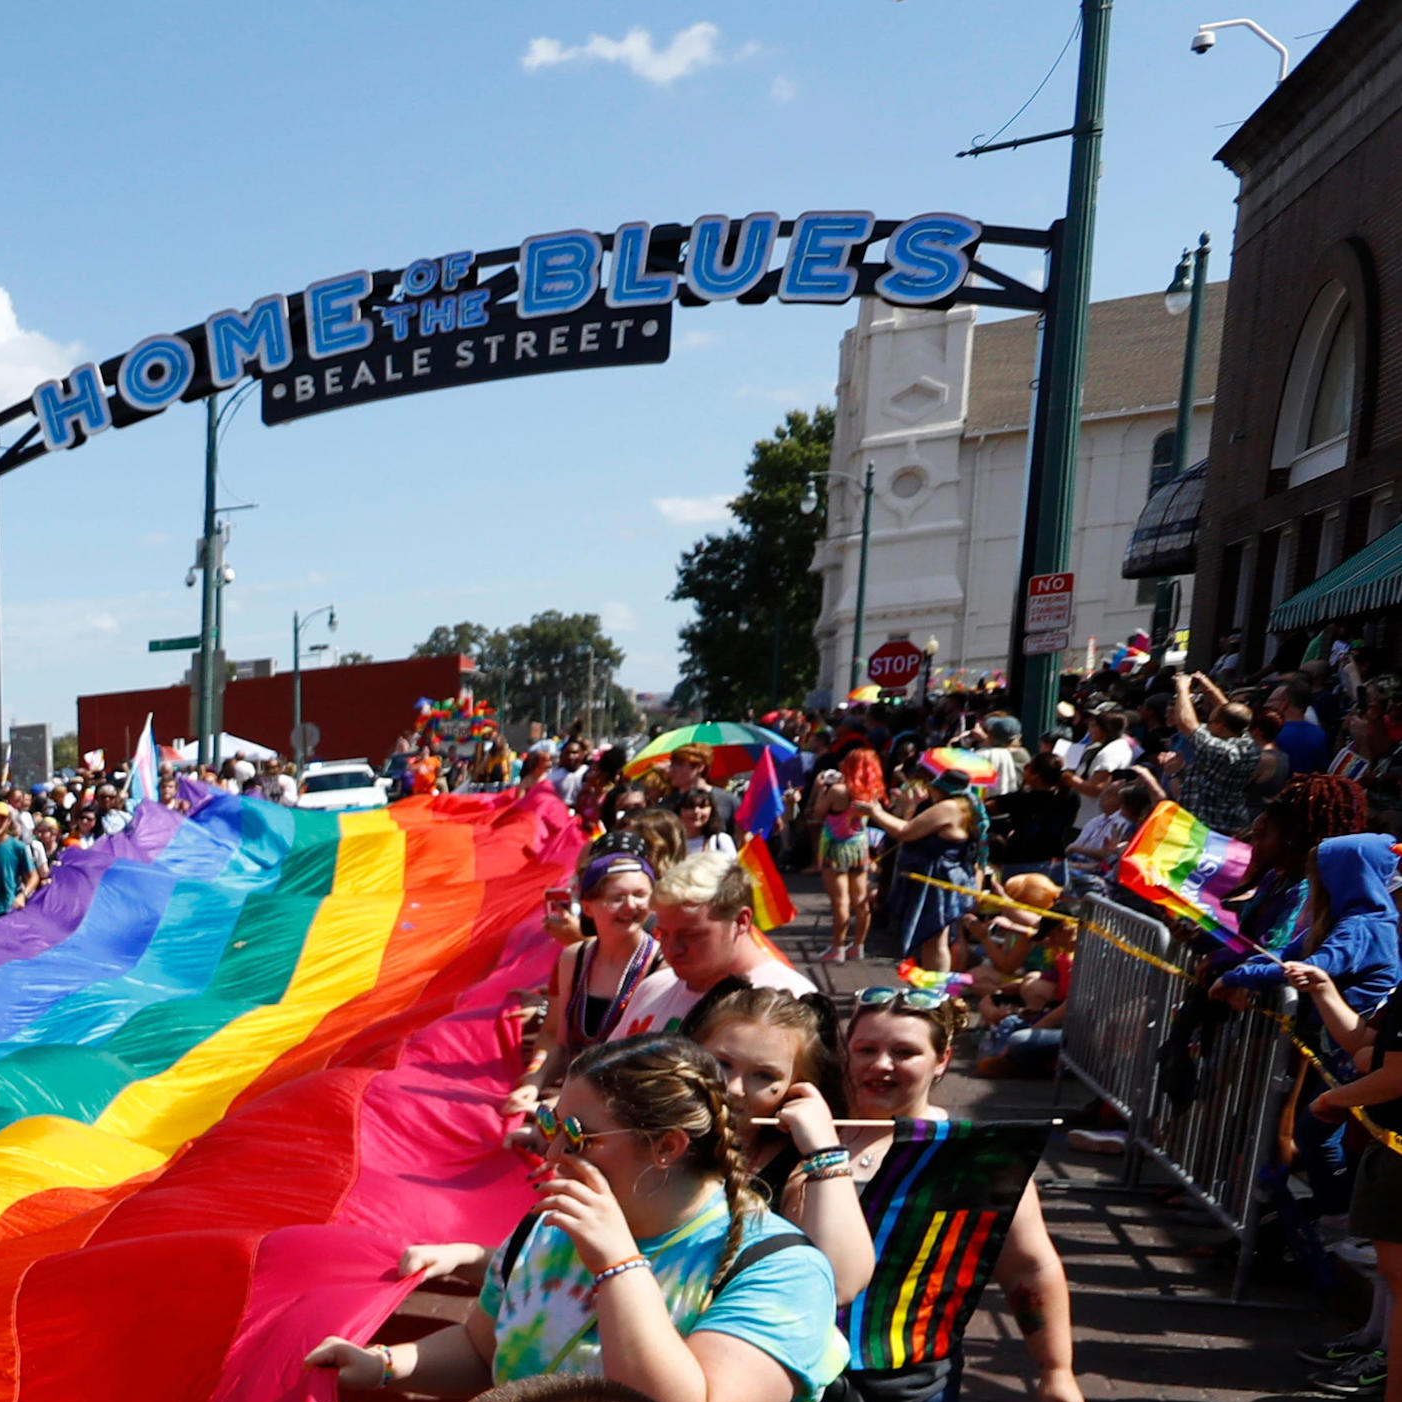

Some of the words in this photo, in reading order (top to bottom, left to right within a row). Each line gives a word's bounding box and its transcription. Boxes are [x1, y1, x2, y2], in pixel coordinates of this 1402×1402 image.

[400, 250, 476, 297] OF
[515, 209, 983, 320] BLUES
[381, 289, 491, 342] THE
[32, 270, 373, 451] HOME
[294, 347, 432, 402] BEALE
[455, 319, 634, 369] STREET
[1036, 576, 1066, 593] NO
[870, 653, 920, 676] STOP
